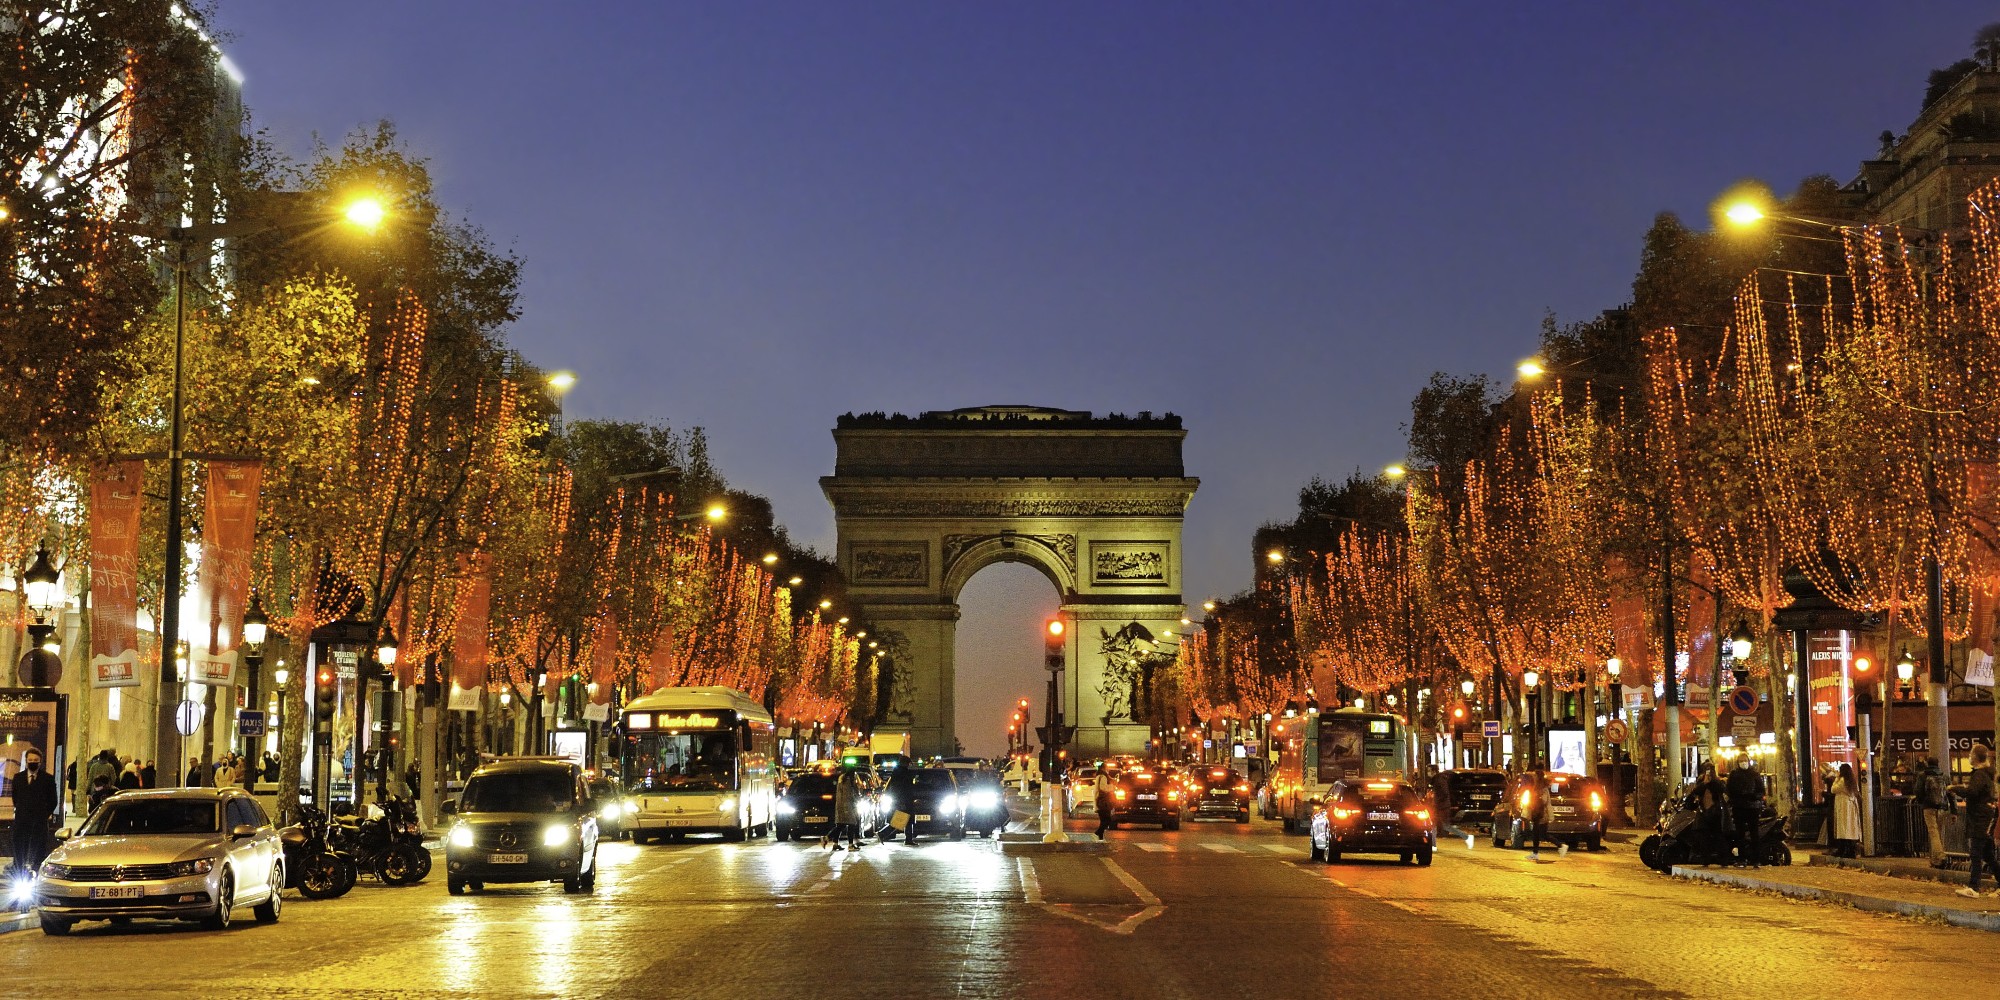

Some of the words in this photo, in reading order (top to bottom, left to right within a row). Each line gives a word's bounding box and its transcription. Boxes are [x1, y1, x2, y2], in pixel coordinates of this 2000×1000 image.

[1812, 652, 1831, 660] ALEXIS
[241, 719, 263, 727] TAXIS
[1912, 737, 1980, 750] GERGE
